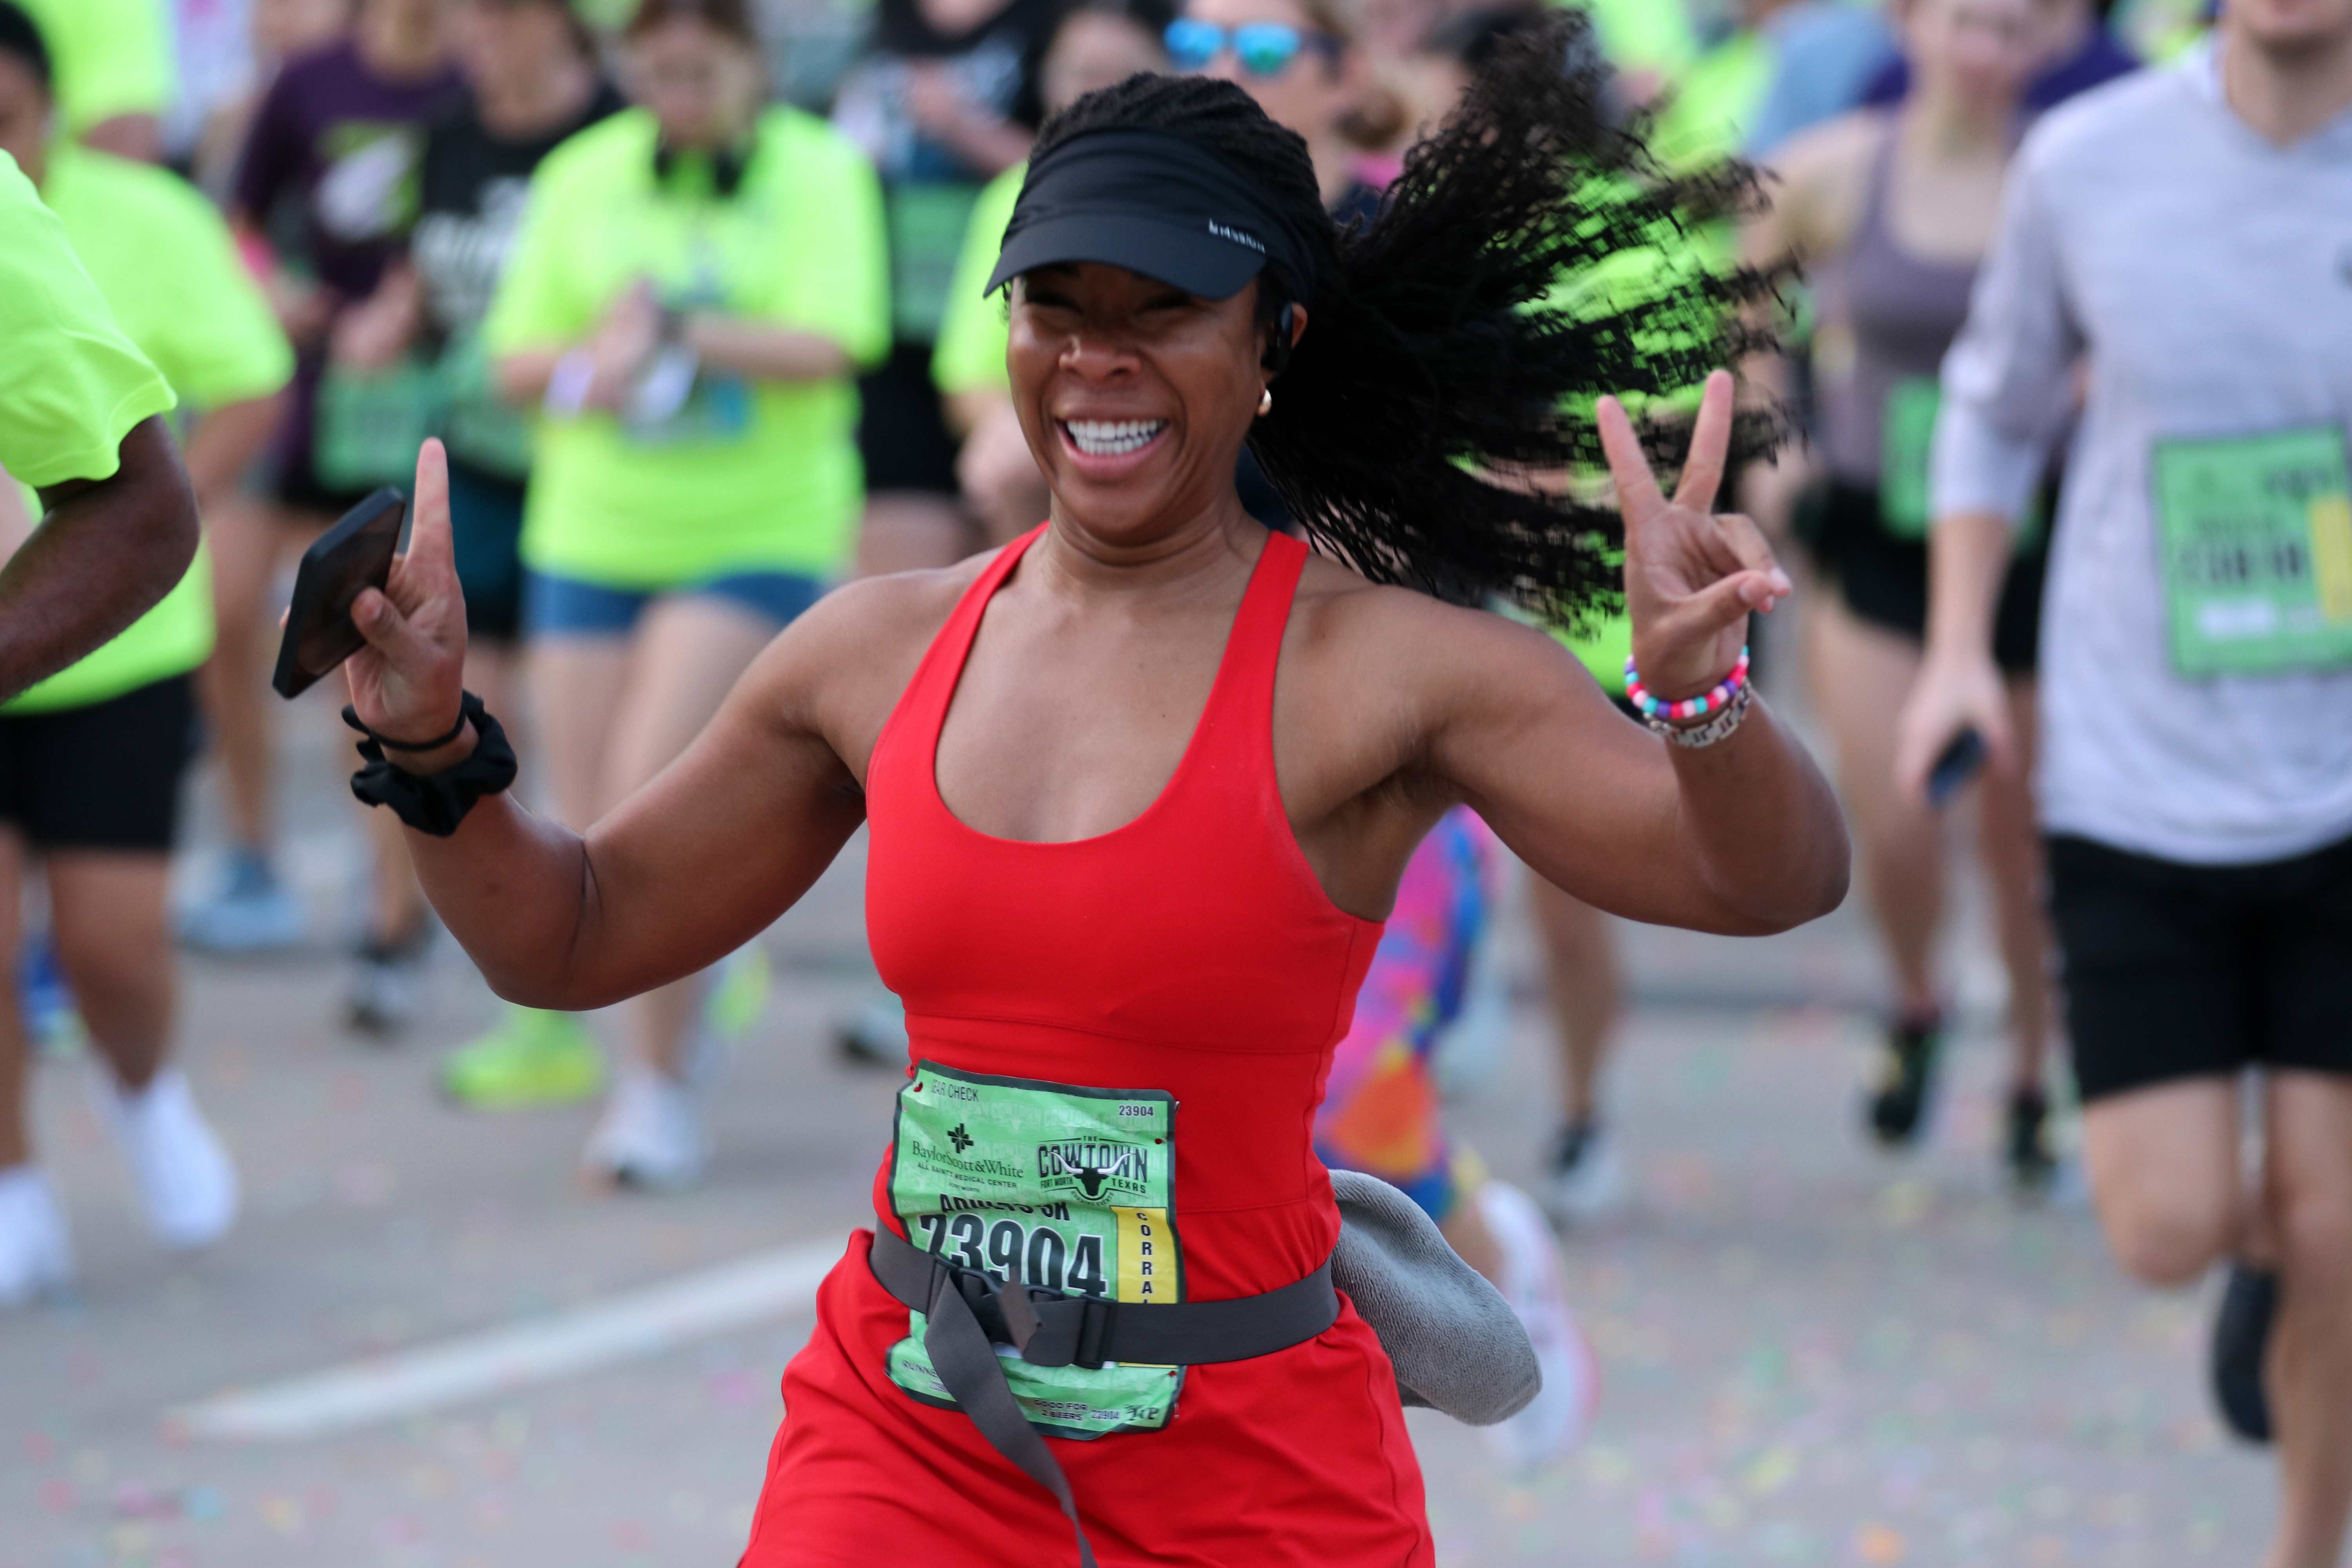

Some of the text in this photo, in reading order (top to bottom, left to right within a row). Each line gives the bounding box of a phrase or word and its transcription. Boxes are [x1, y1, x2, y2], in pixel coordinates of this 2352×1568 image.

[948, 1083, 980, 1102] CHECK
[1118, 1105, 1154, 1116] 23904
[1037, 1143, 1147, 1183] COWTOWN
[917, 1162, 1017, 1188] ALL SAINTS MEDICAL CENTER
[1041, 1177, 1073, 1189] FORT WORTH
[1112, 1178, 1146, 1194] TEXAS
[1096, 1192, 1114, 1206] EVENTS
[1136, 1212, 1152, 1303] CORRA
[902, 1359, 940, 1378] RUNNE
[1034, 1399, 1088, 1411] GOOD FOR
[1050, 1411, 1082, 1421] BEERS
